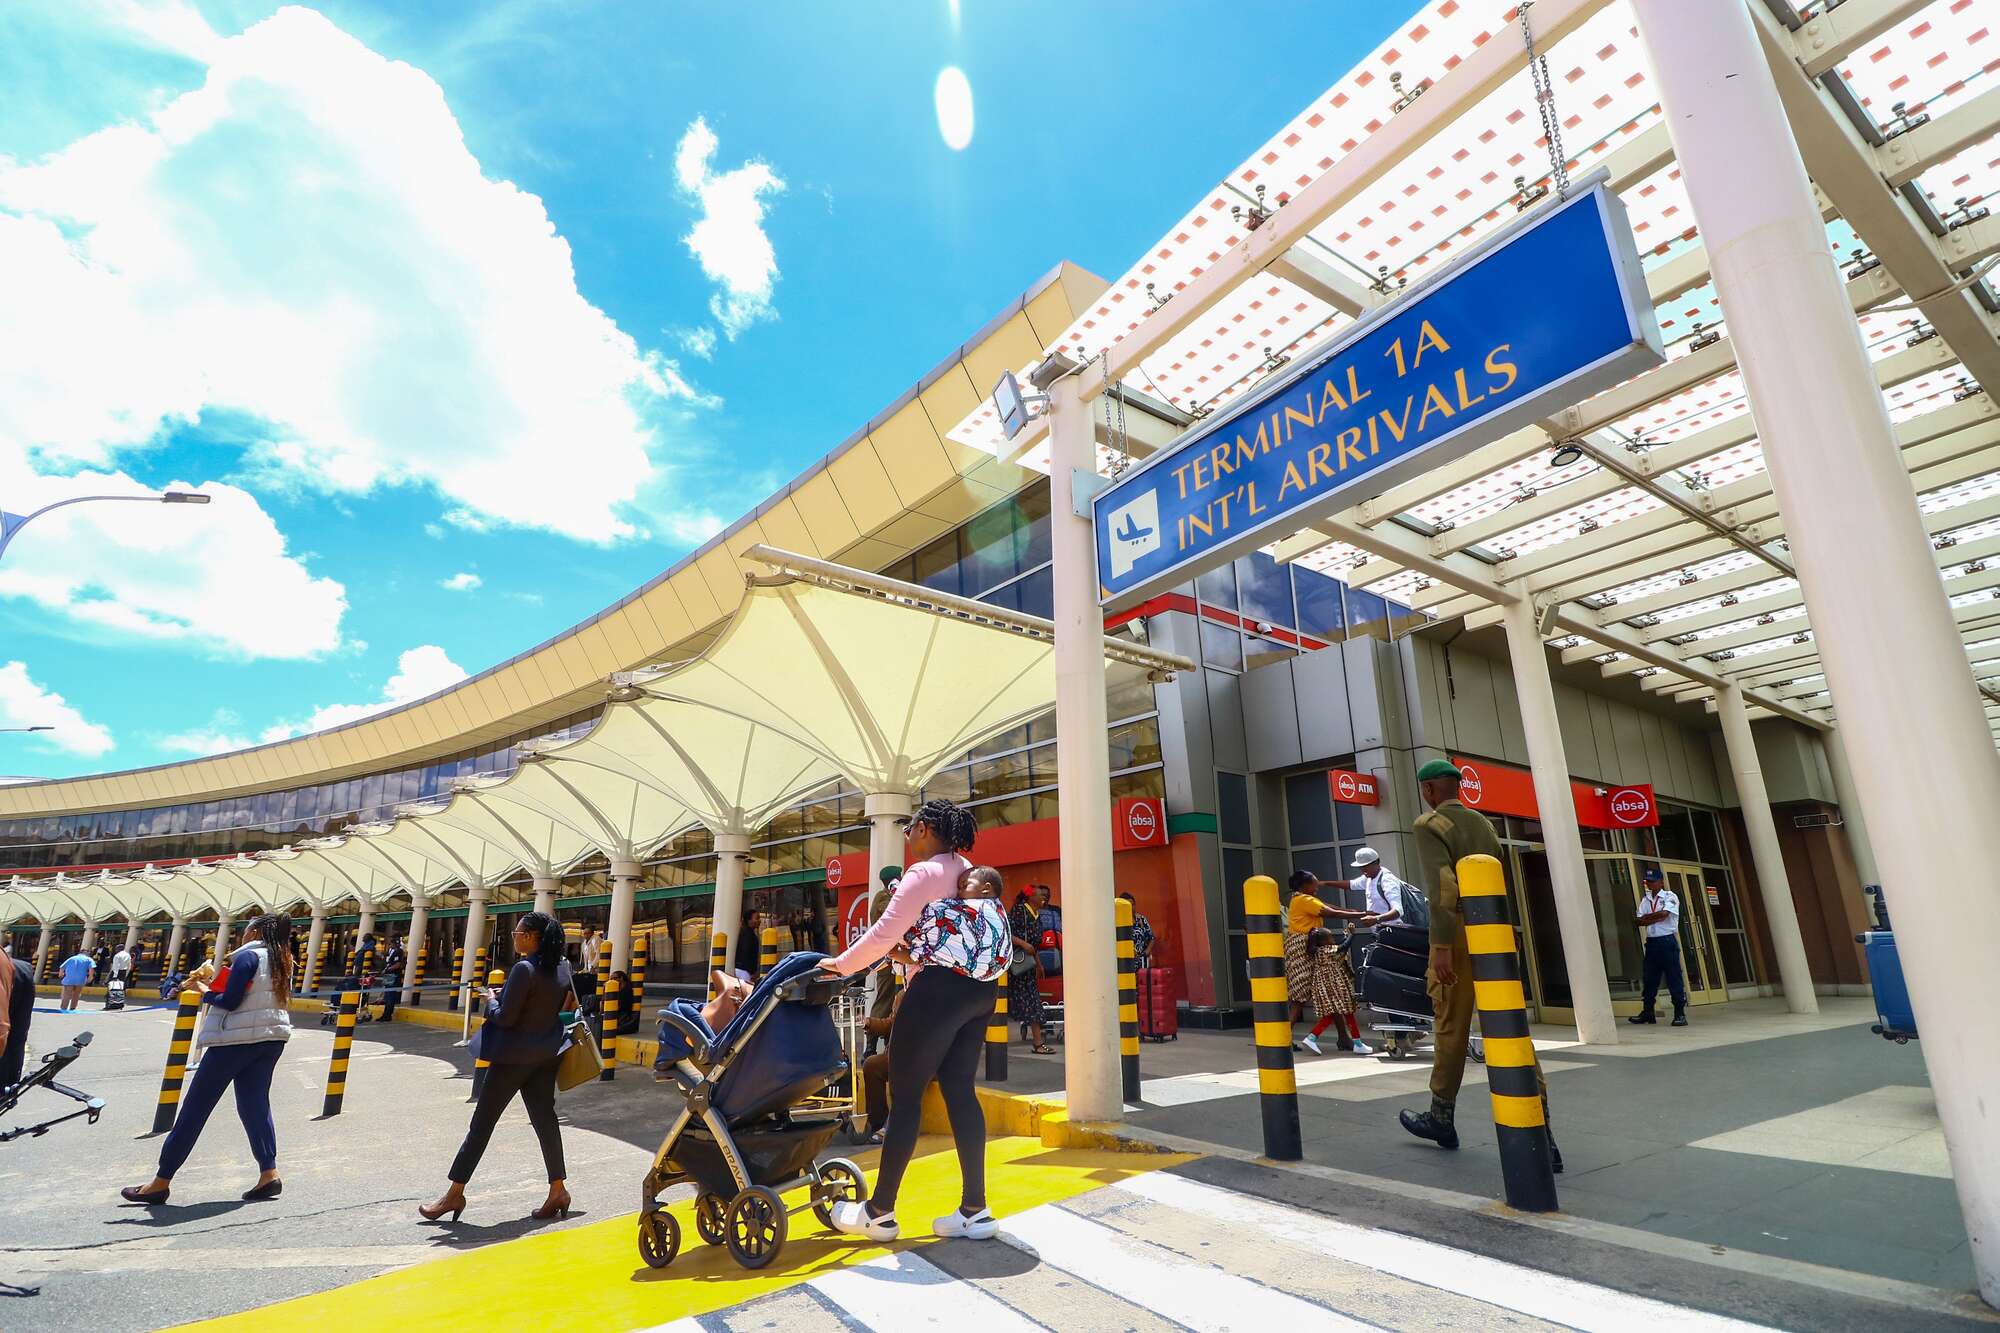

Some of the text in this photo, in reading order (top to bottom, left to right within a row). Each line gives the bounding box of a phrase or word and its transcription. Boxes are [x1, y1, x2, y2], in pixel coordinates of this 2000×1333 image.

[1171, 319, 1451, 500] TERMINAL 1A
[1178, 344, 1518, 551] INT'L ARRIVALS
[1358, 783, 1374, 795] ATM
[1462, 776, 1479, 790] absa
[1615, 800, 1645, 812] absa
[1132, 813, 1153, 826] absa
